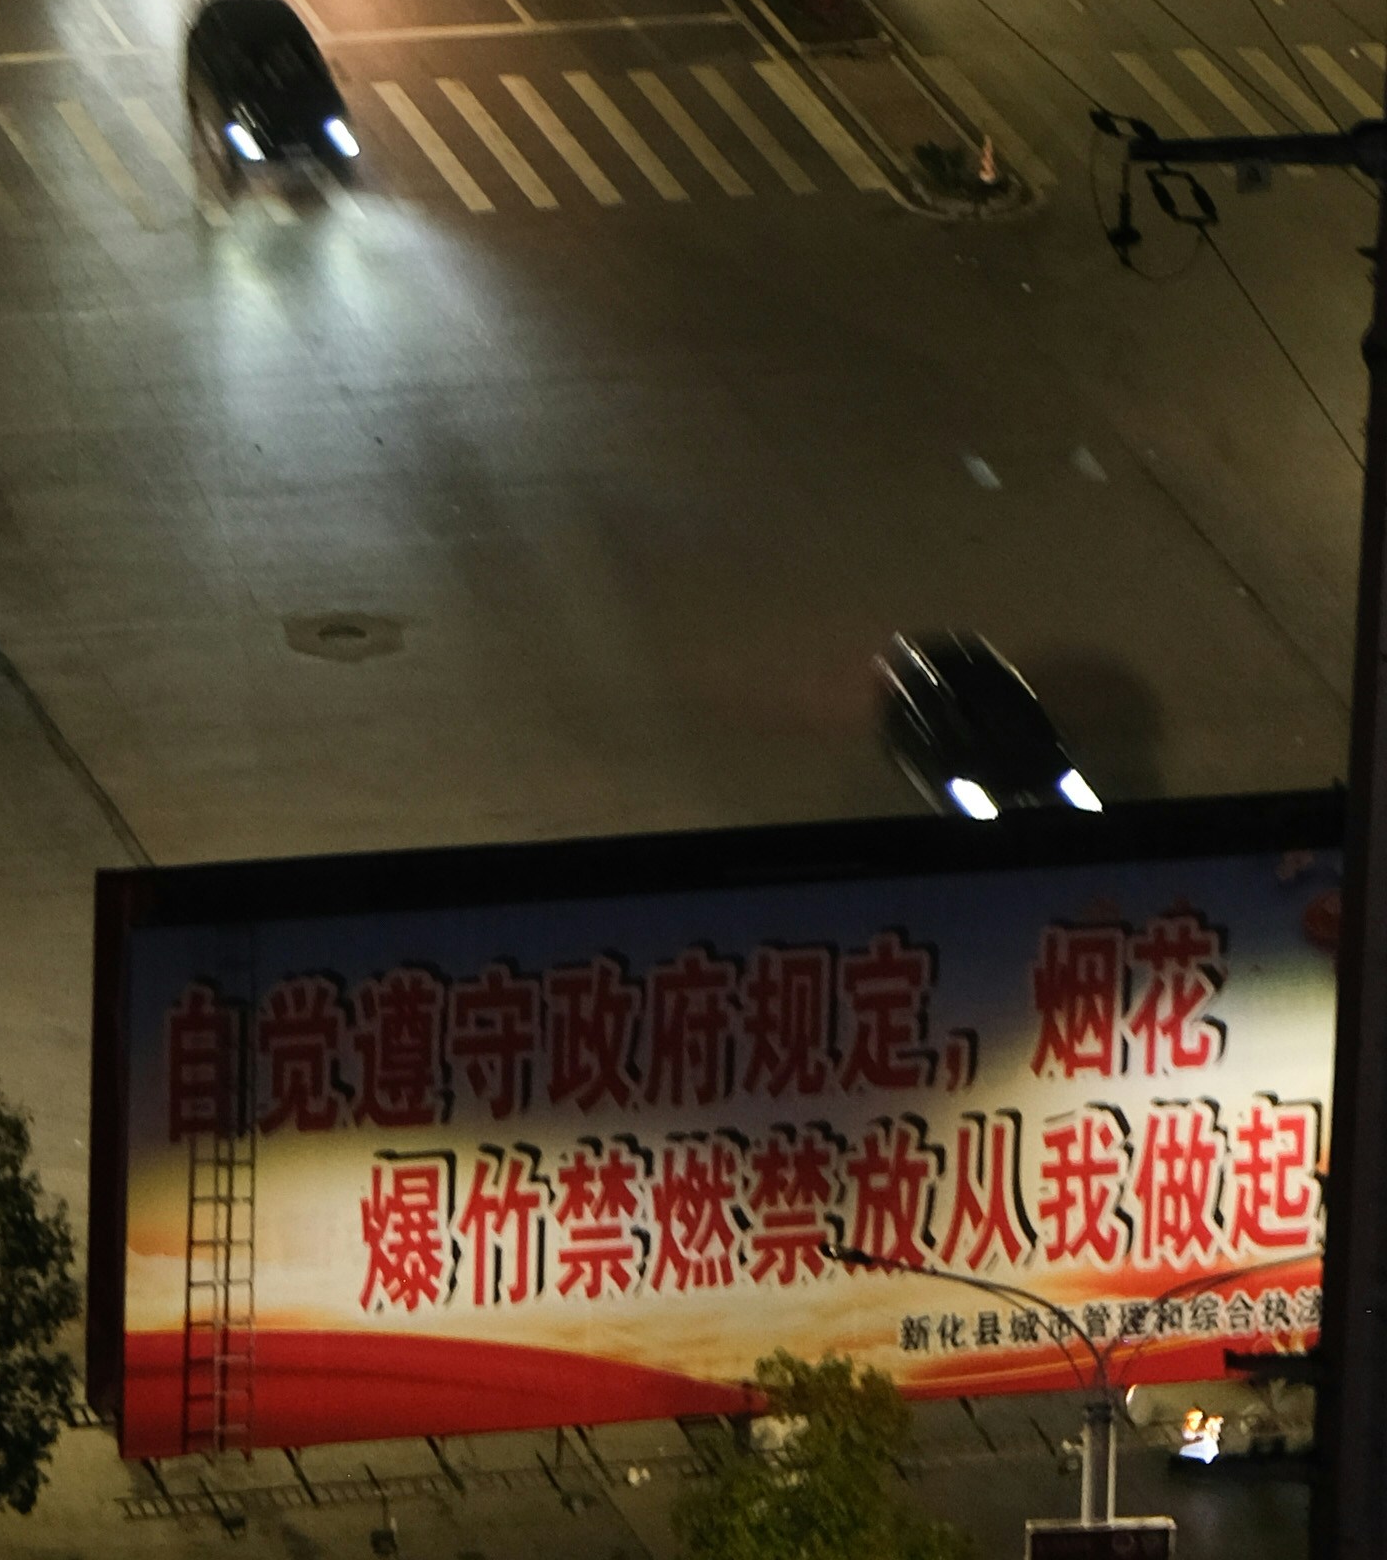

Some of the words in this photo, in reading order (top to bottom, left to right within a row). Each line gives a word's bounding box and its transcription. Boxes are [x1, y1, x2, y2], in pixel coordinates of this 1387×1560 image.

[360, 1104, 1321, 1310] 爆竹禁燃禁放从我做起
